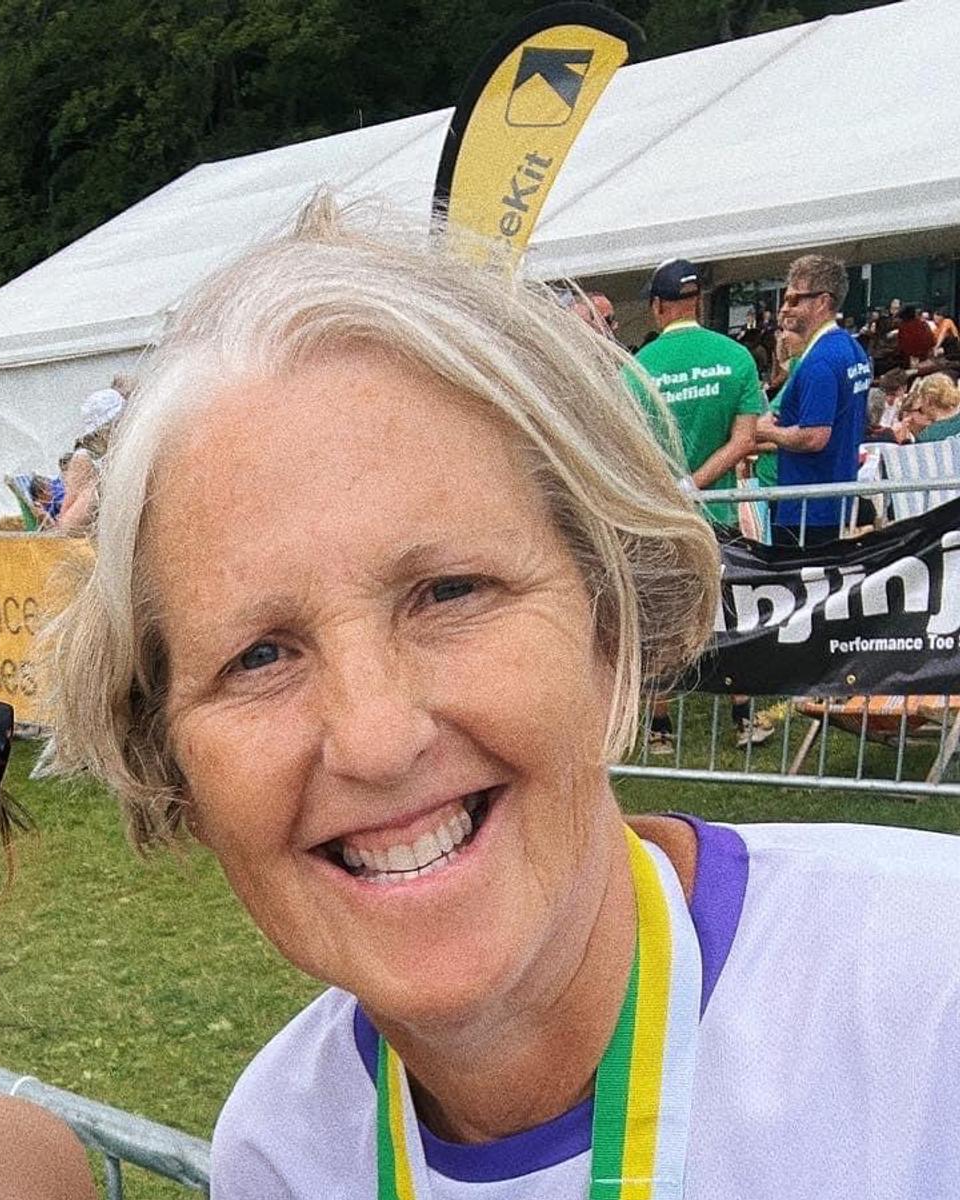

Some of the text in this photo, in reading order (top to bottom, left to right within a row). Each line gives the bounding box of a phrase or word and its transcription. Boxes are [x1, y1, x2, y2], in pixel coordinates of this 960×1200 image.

[497, 150, 554, 246] eKit
[651, 363, 732, 387] rban Peaks
[830, 636, 924, 653] Performance
[929, 634, 954, 649] Toe
